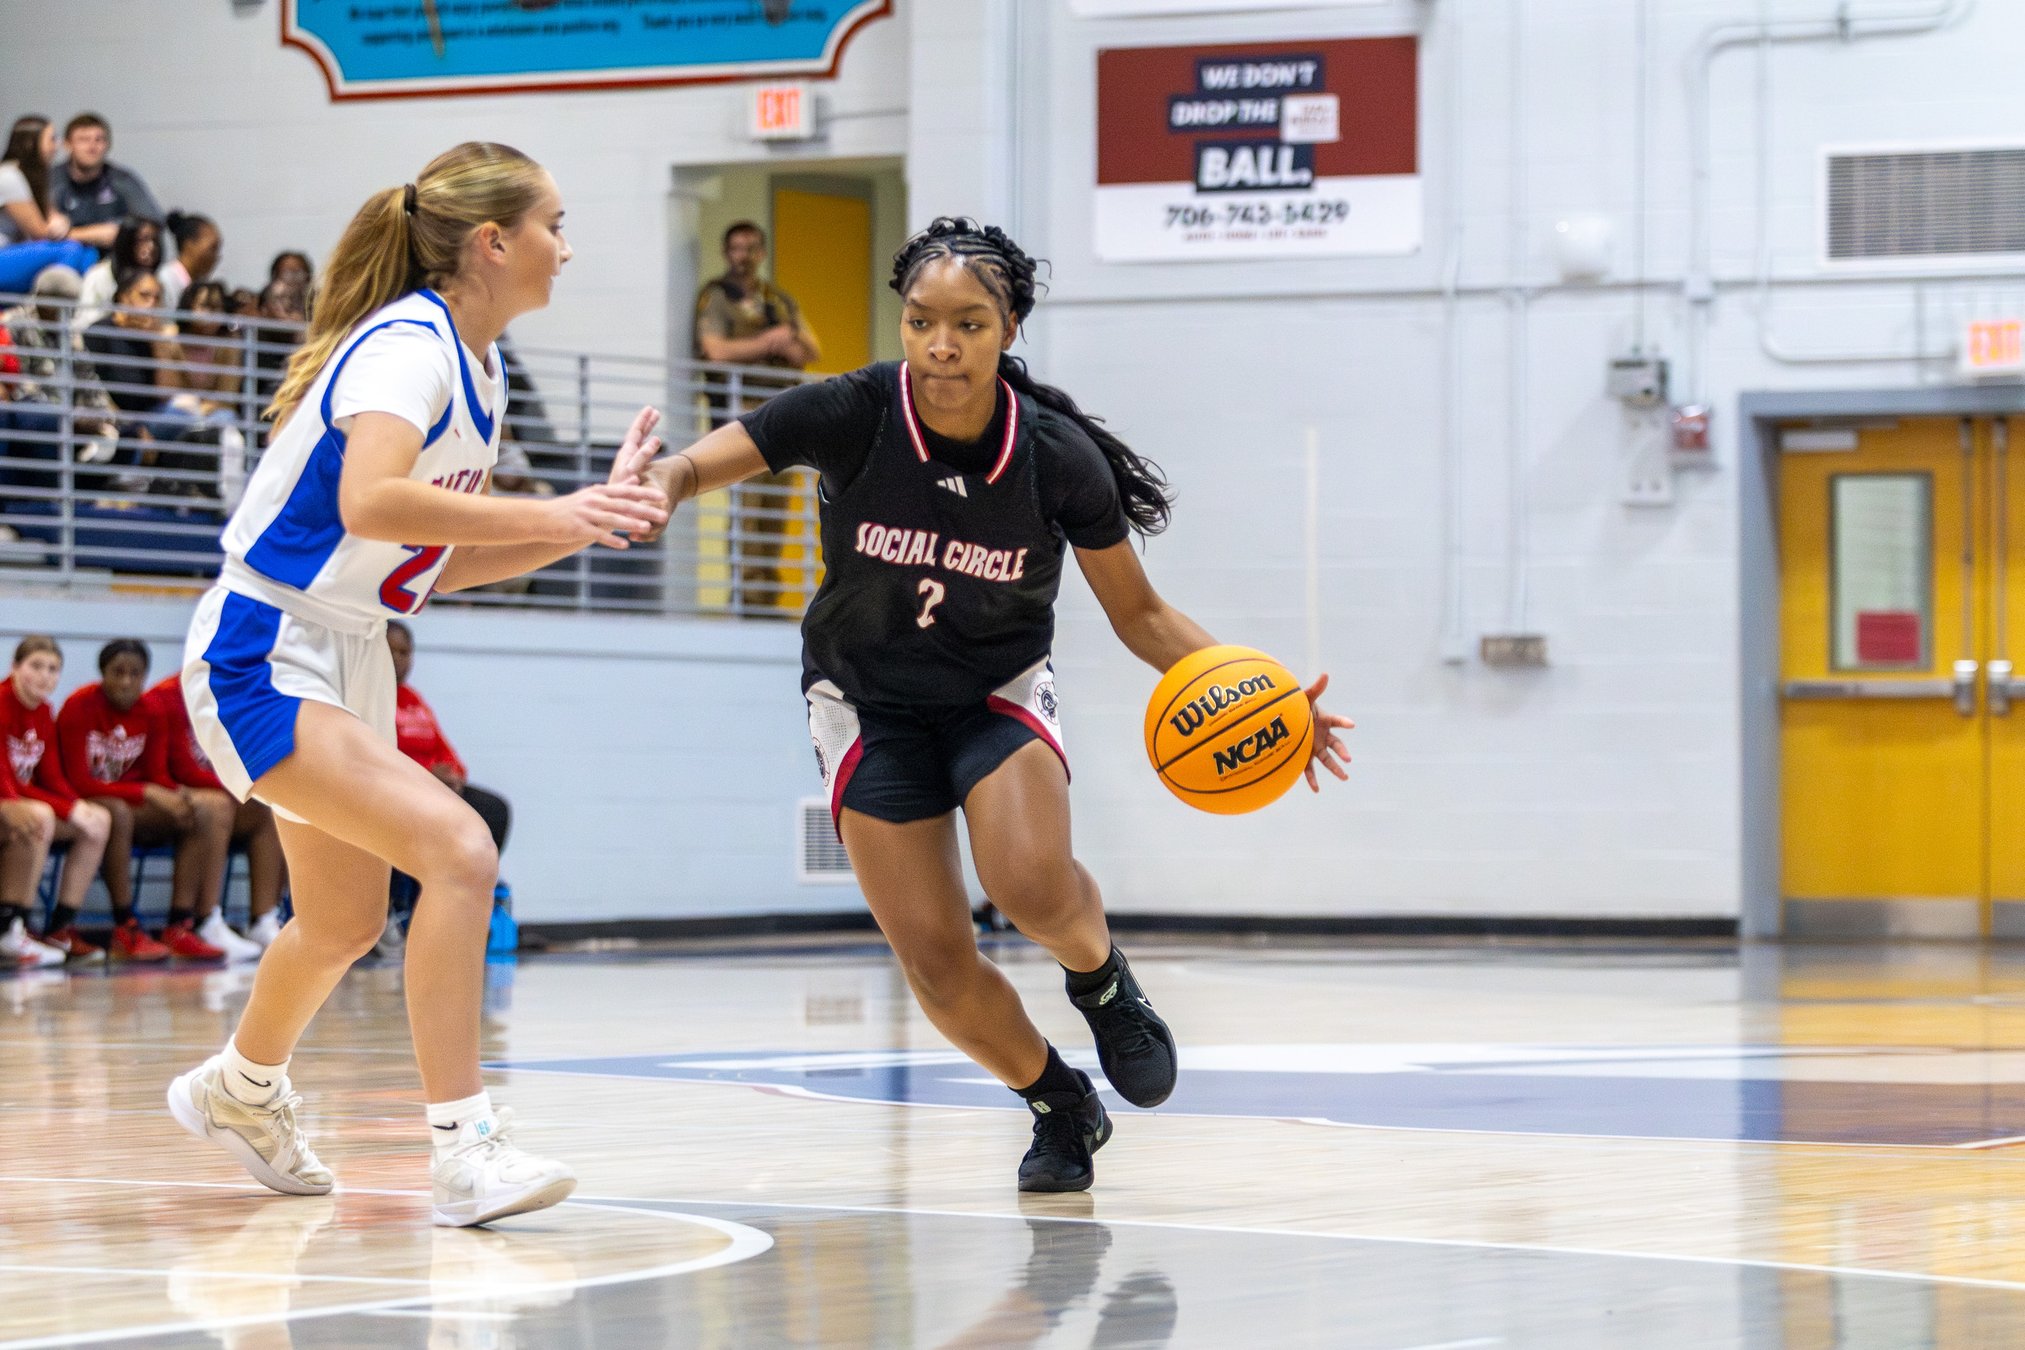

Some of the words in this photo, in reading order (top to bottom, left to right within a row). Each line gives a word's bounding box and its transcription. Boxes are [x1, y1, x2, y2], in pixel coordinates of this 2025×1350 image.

[1202, 64, 1239, 89] WE
[1244, 59, 1318, 87] DON'T
[757, 88, 801, 130] EXIT
[1171, 102, 1234, 127] DROP
[1236, 97, 1279, 124] THE
[1200, 145, 1314, 188] BALL.
[1968, 319, 2020, 365] EXIT
[855, 521, 940, 567] SOCIAL
[942, 539, 1028, 582] CIRCLE
[915, 577, 946, 628] 2
[1169, 673, 1276, 737] Wilson
[1212, 714, 1291, 776] NCAA
